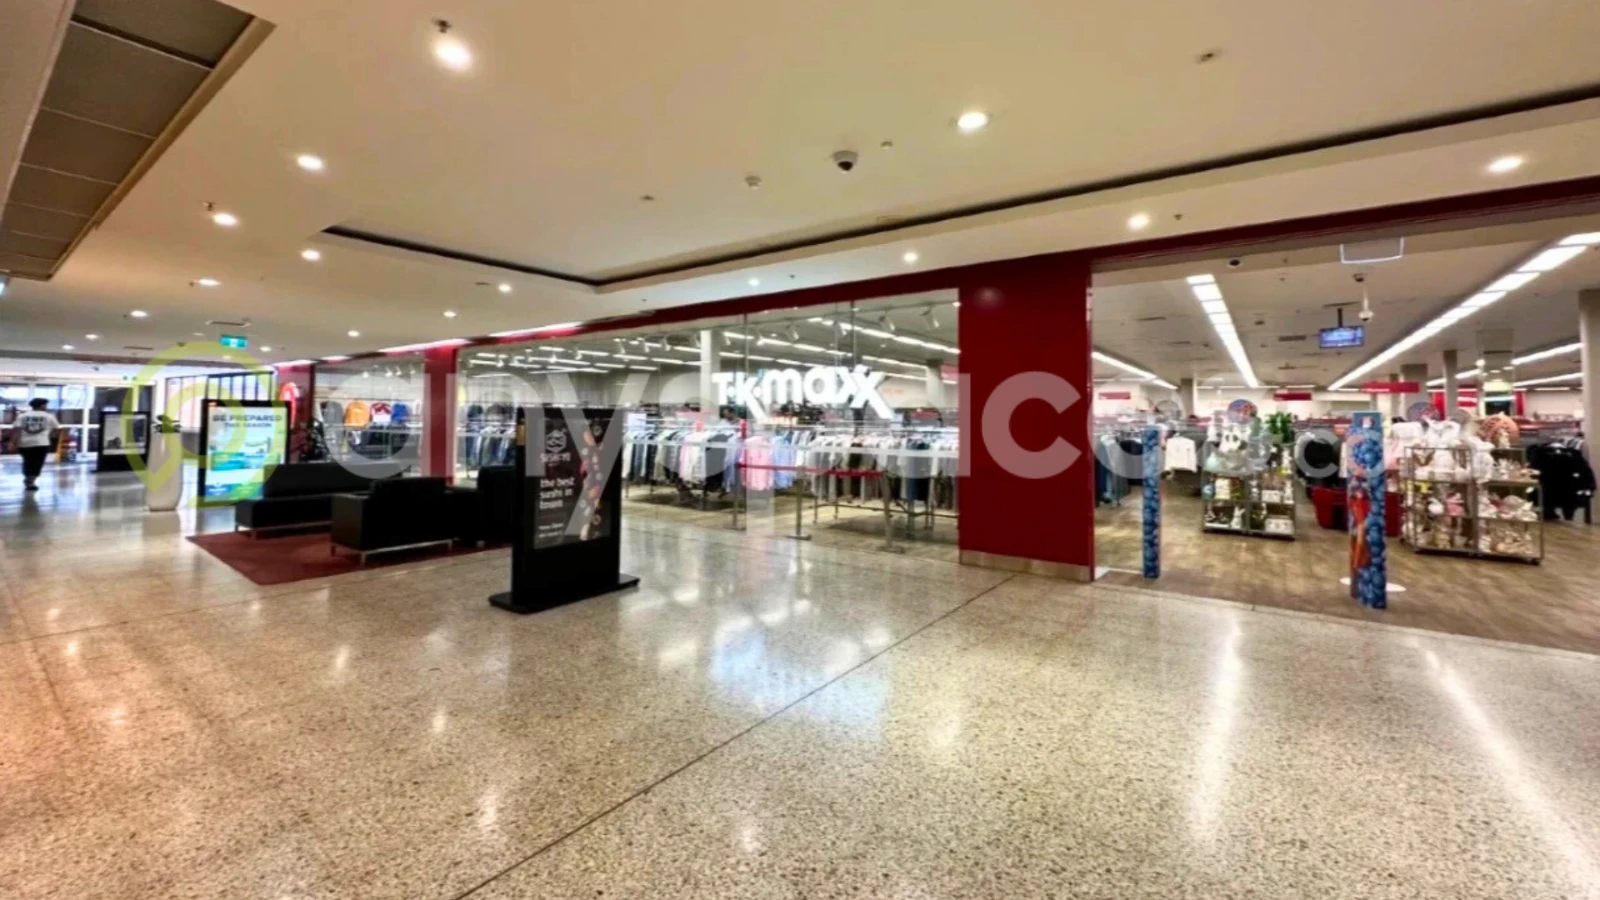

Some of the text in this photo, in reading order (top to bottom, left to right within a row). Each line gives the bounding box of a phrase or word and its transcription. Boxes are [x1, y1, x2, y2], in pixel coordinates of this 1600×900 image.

[540, 477, 575, 488] the best
[539, 489, 563, 499] sushi
